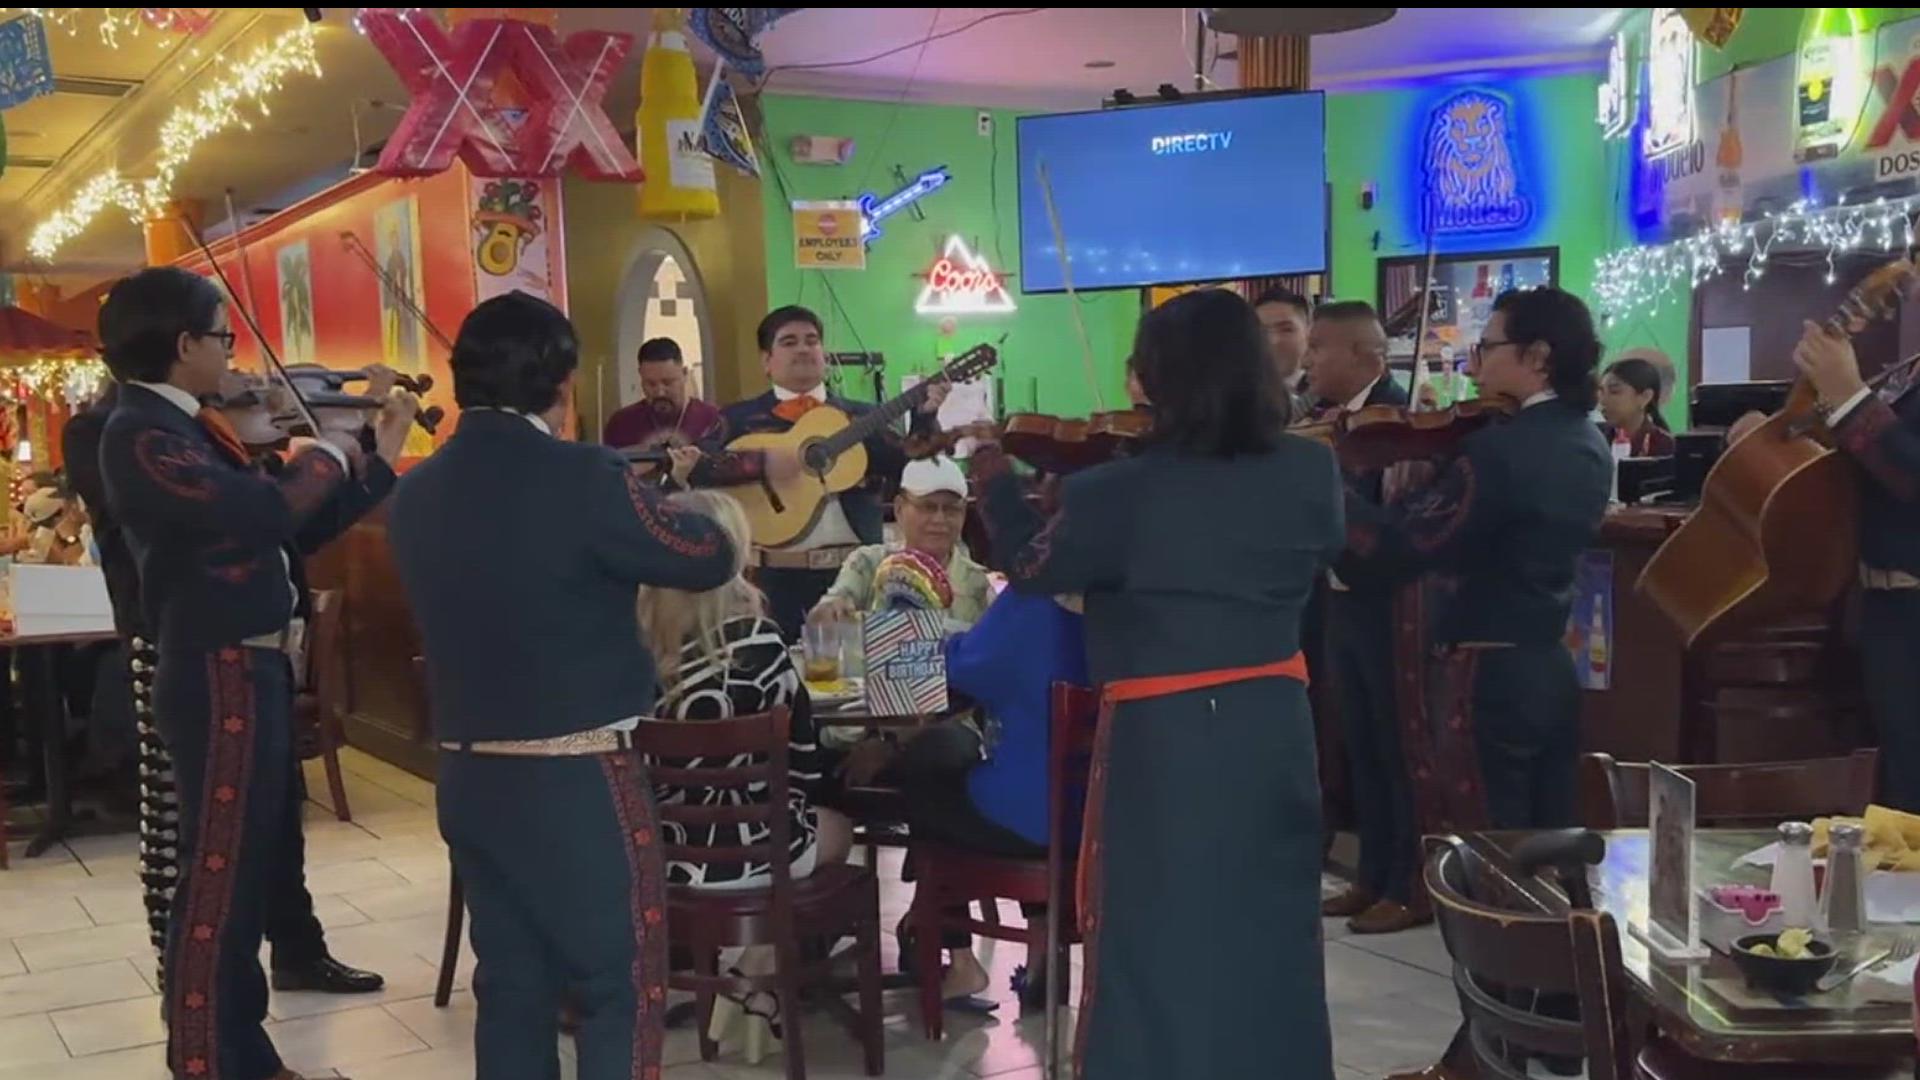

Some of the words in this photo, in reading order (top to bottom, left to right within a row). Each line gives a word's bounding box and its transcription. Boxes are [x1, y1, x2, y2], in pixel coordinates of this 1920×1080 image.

[1151, 131, 1232, 155] DIRECTV
[1880, 150, 1920, 176] DOS
[798, 238, 858, 248] EMPLOYEES
[815, 251, 842, 261] ONLY
[930, 259, 1000, 293] Coors
[901, 641, 939, 656] HAPPY
[888, 661, 942, 678] BIRTHDAY
